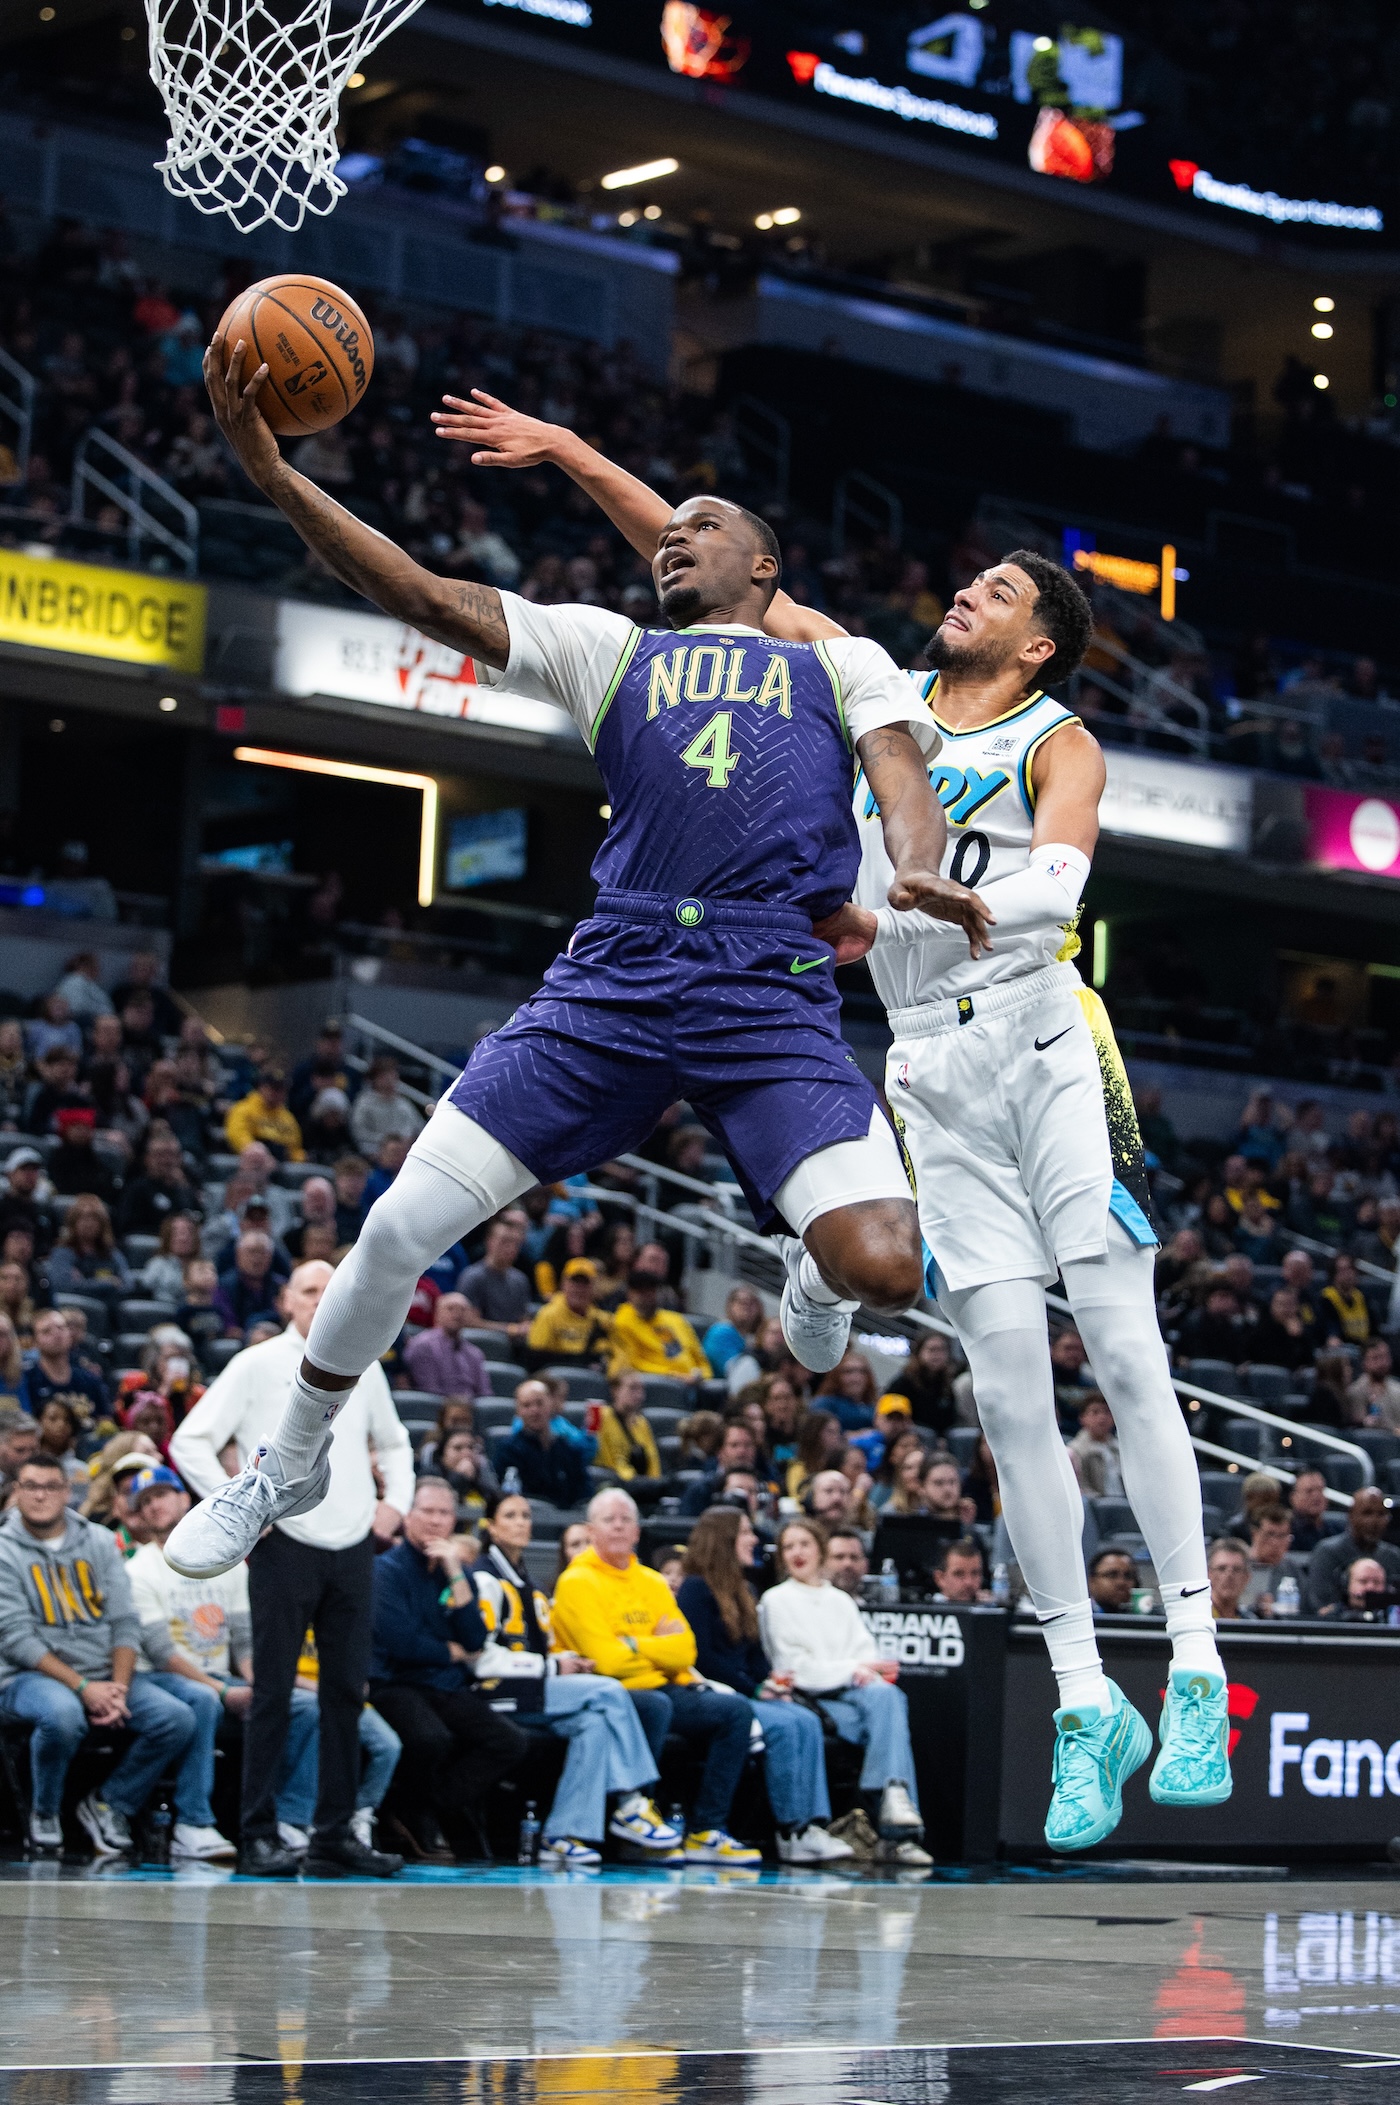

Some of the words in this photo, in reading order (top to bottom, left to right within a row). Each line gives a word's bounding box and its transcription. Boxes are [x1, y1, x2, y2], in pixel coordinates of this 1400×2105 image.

[309, 296, 366, 397] Wilson
[0, 574, 191, 651] NBRIDGE
[646, 645, 793, 721] NOLA
[679, 710, 741, 788] 4
[949, 830, 991, 890] 0
